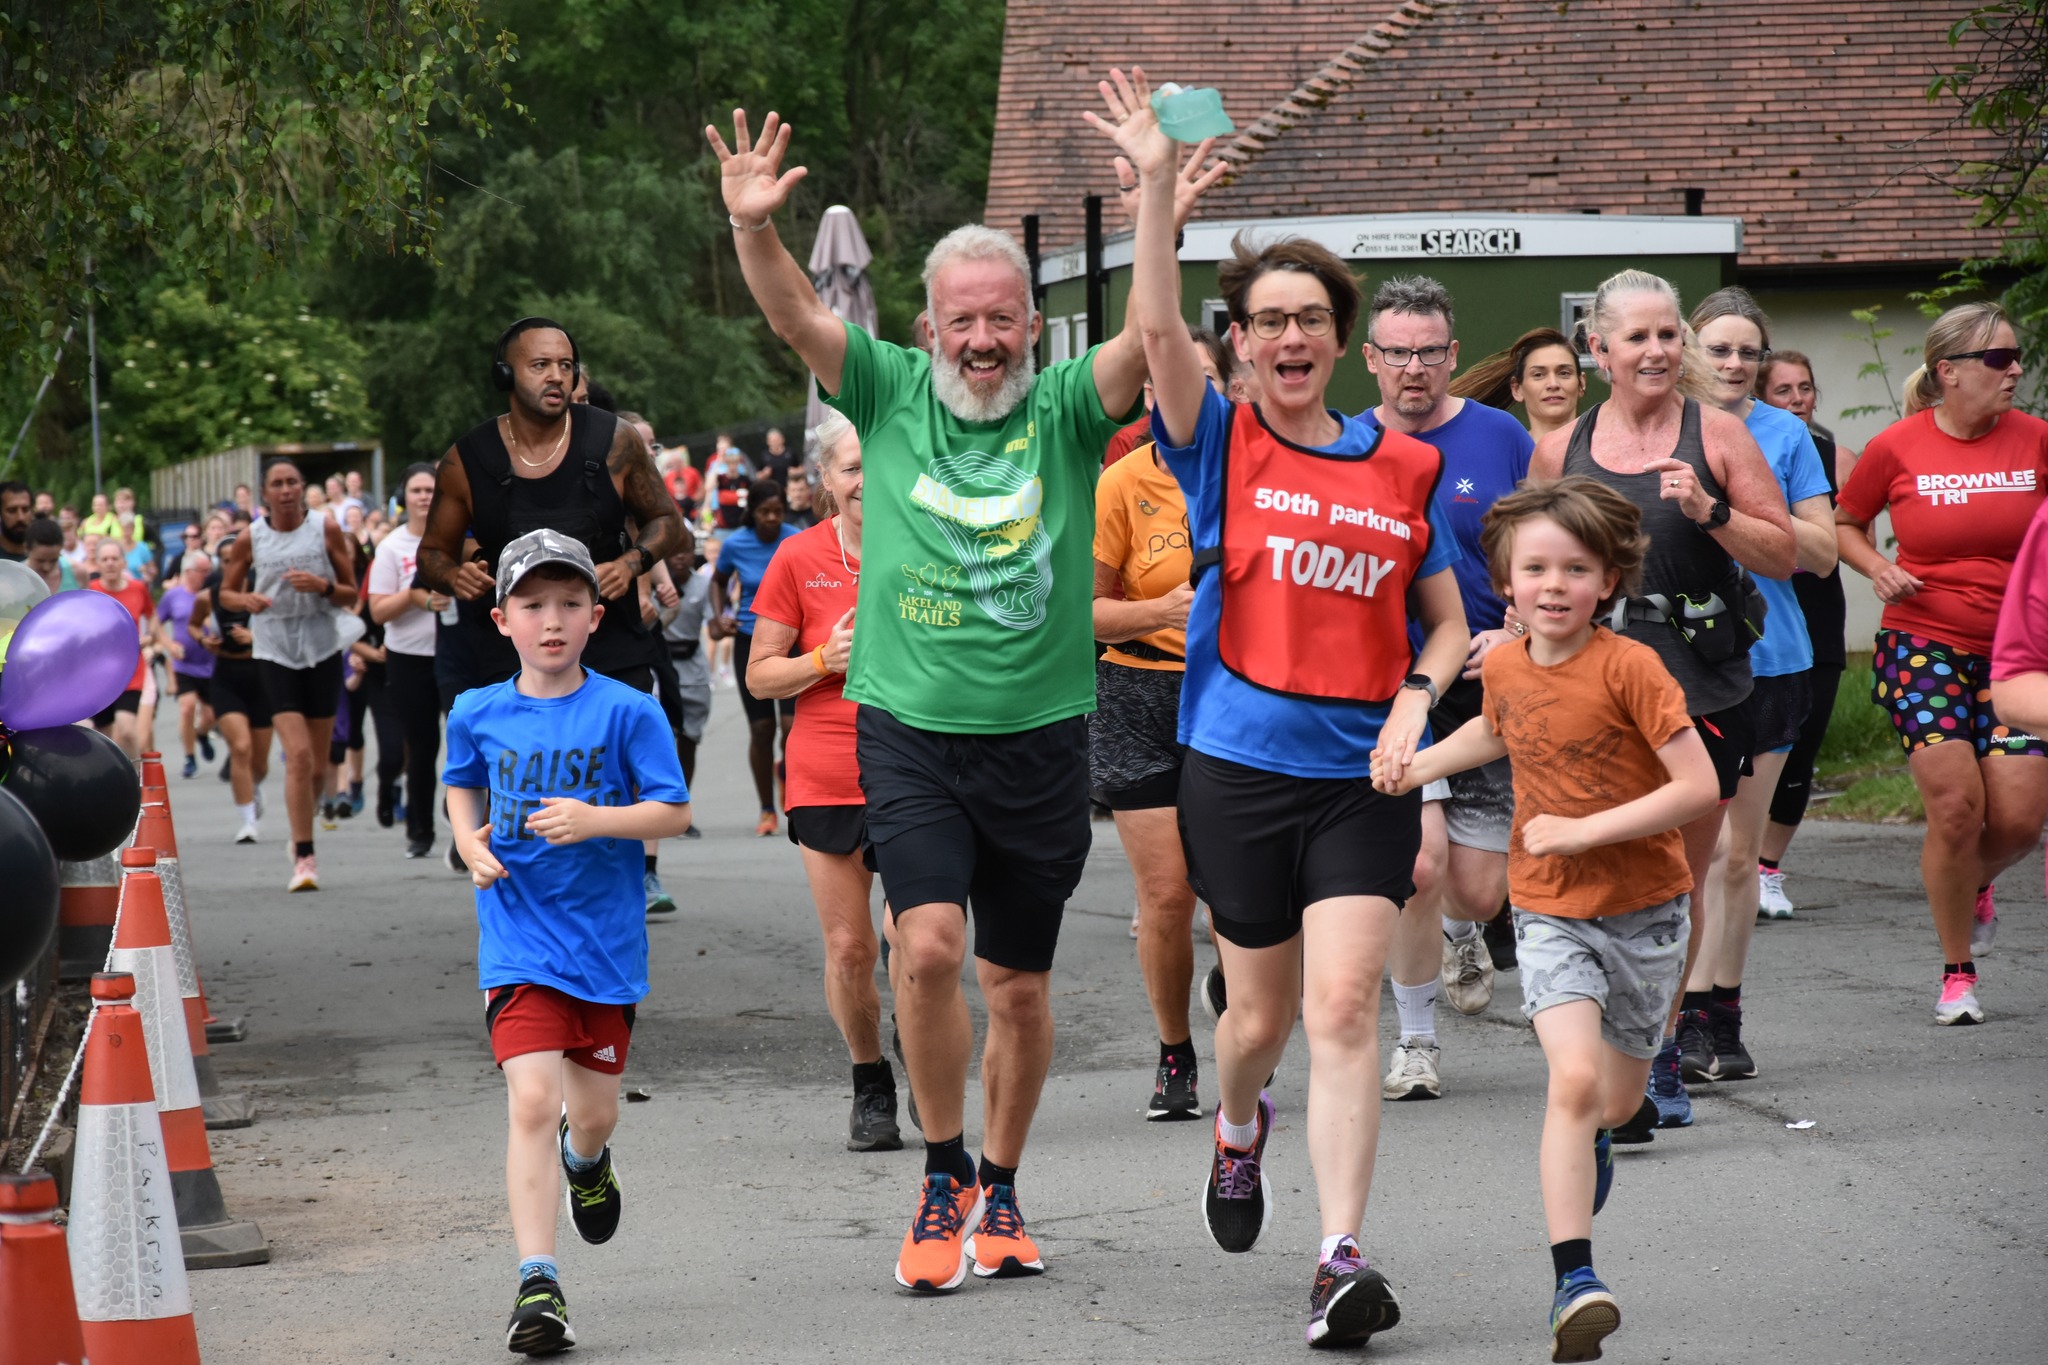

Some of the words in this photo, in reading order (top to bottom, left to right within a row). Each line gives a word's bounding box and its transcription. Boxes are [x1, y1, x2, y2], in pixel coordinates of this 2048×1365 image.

[1356, 233, 1369, 241] ON
[1425, 228, 1516, 255] SEARCH
[1916, 469, 2037, 490] BROWNLEE
[1930, 489, 1968, 506] TRI
[1254, 487, 1319, 517] 50th
[1329, 503, 1411, 541] parkrun
[1266, 535, 1396, 598] TODAY
[805, 577, 842, 589] parkrun
[899, 592, 962, 611] LAKELAND
[898, 602, 961, 627] TRAILS
[498, 745, 607, 793] RAISE
[592, 1052, 617, 1064] adidas
